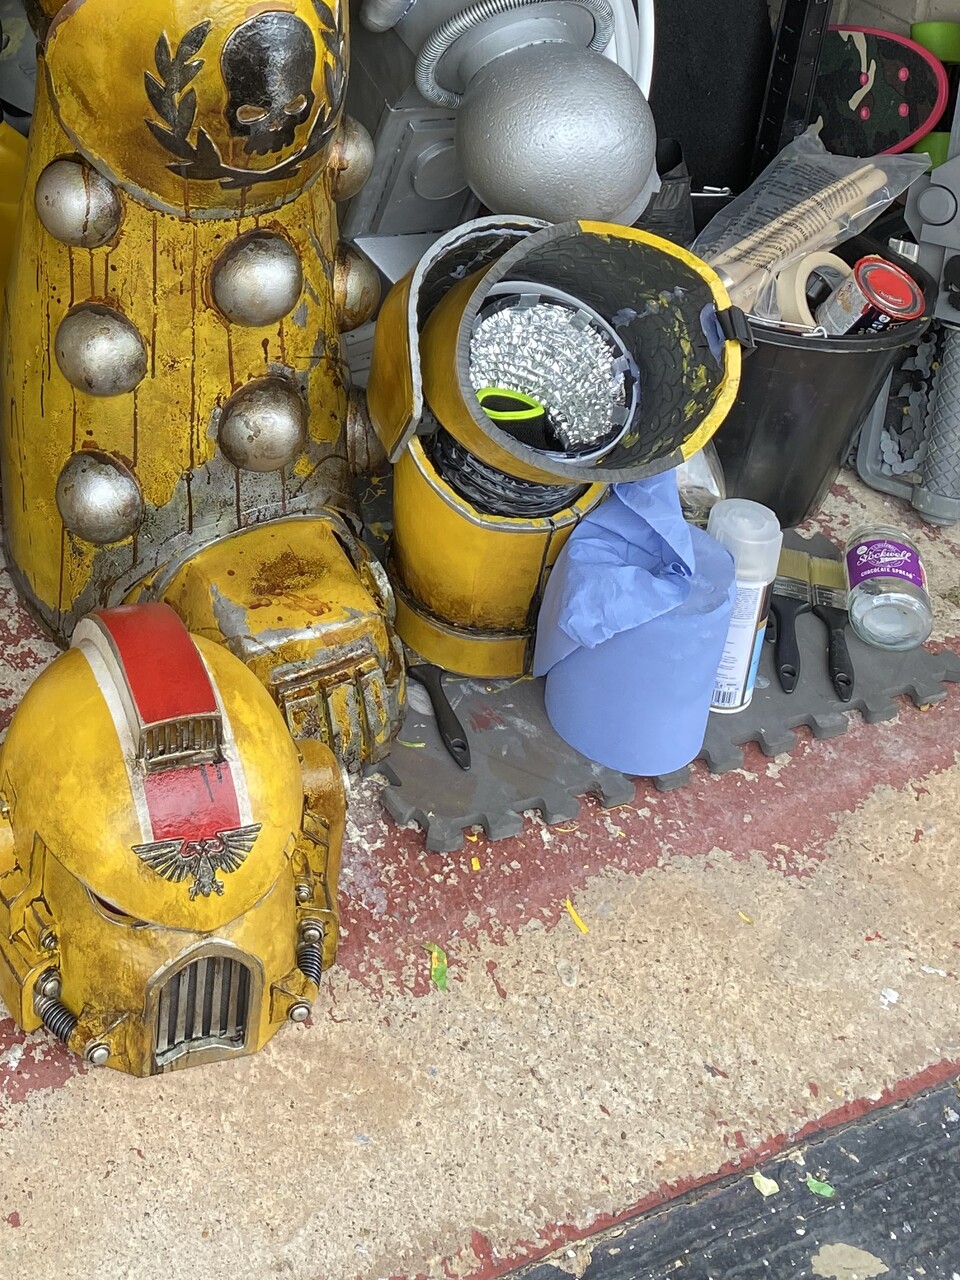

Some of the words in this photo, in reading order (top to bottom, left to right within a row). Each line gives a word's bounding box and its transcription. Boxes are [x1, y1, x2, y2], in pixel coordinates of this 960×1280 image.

[856, 548, 912, 566] Stockwell
[860, 567, 891, 577] CHOCOLATE
[892, 568, 914, 579] SPREAD
